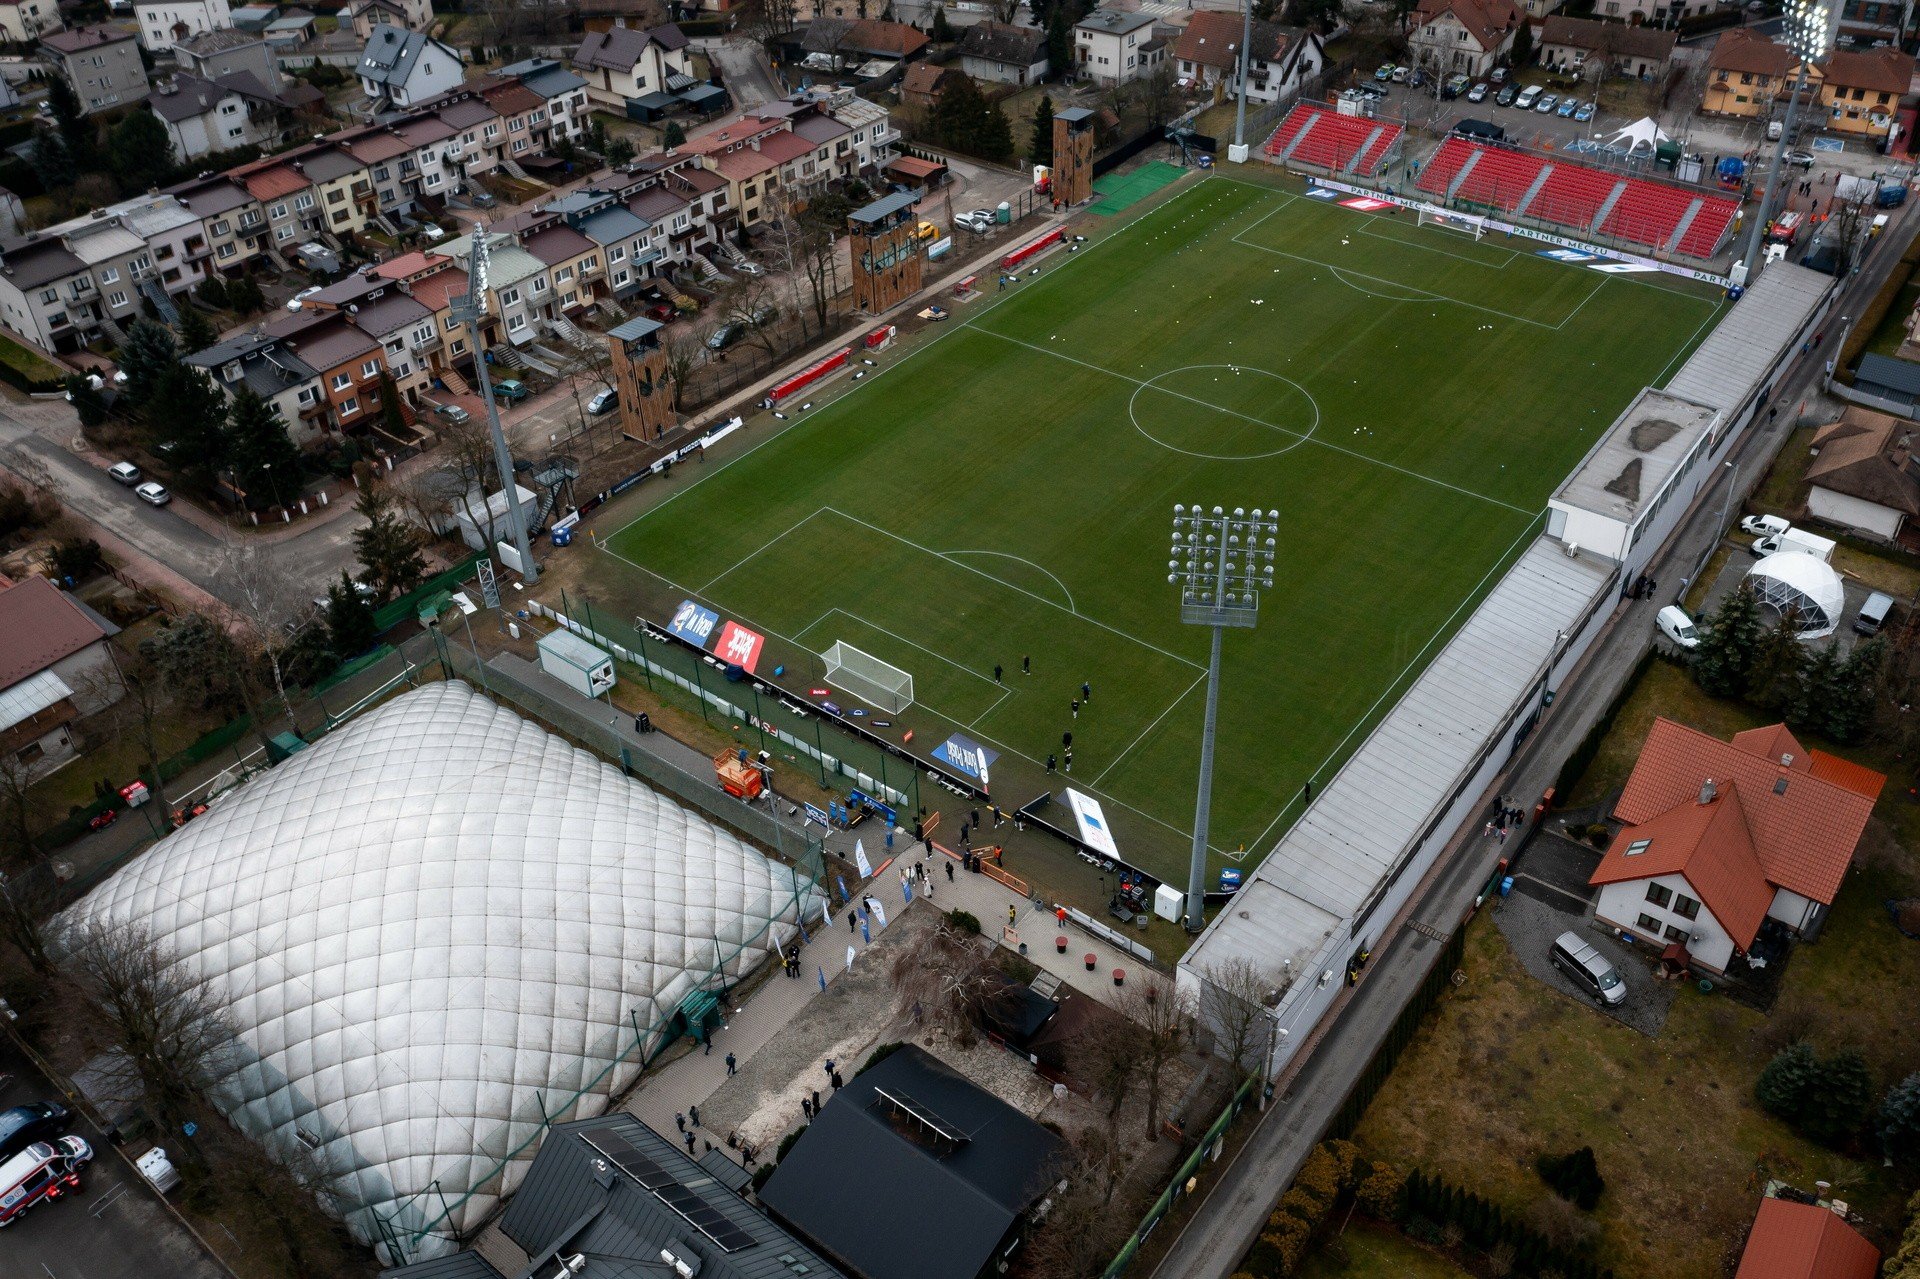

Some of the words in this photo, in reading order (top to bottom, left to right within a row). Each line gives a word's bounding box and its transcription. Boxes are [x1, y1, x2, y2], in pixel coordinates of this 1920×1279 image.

[1351, 186, 1396, 202] PARTNER
[1514, 227, 1563, 244] PARTNER
[1568, 240, 1608, 255] MECZU
[1693, 271, 1733, 287] PARTN
